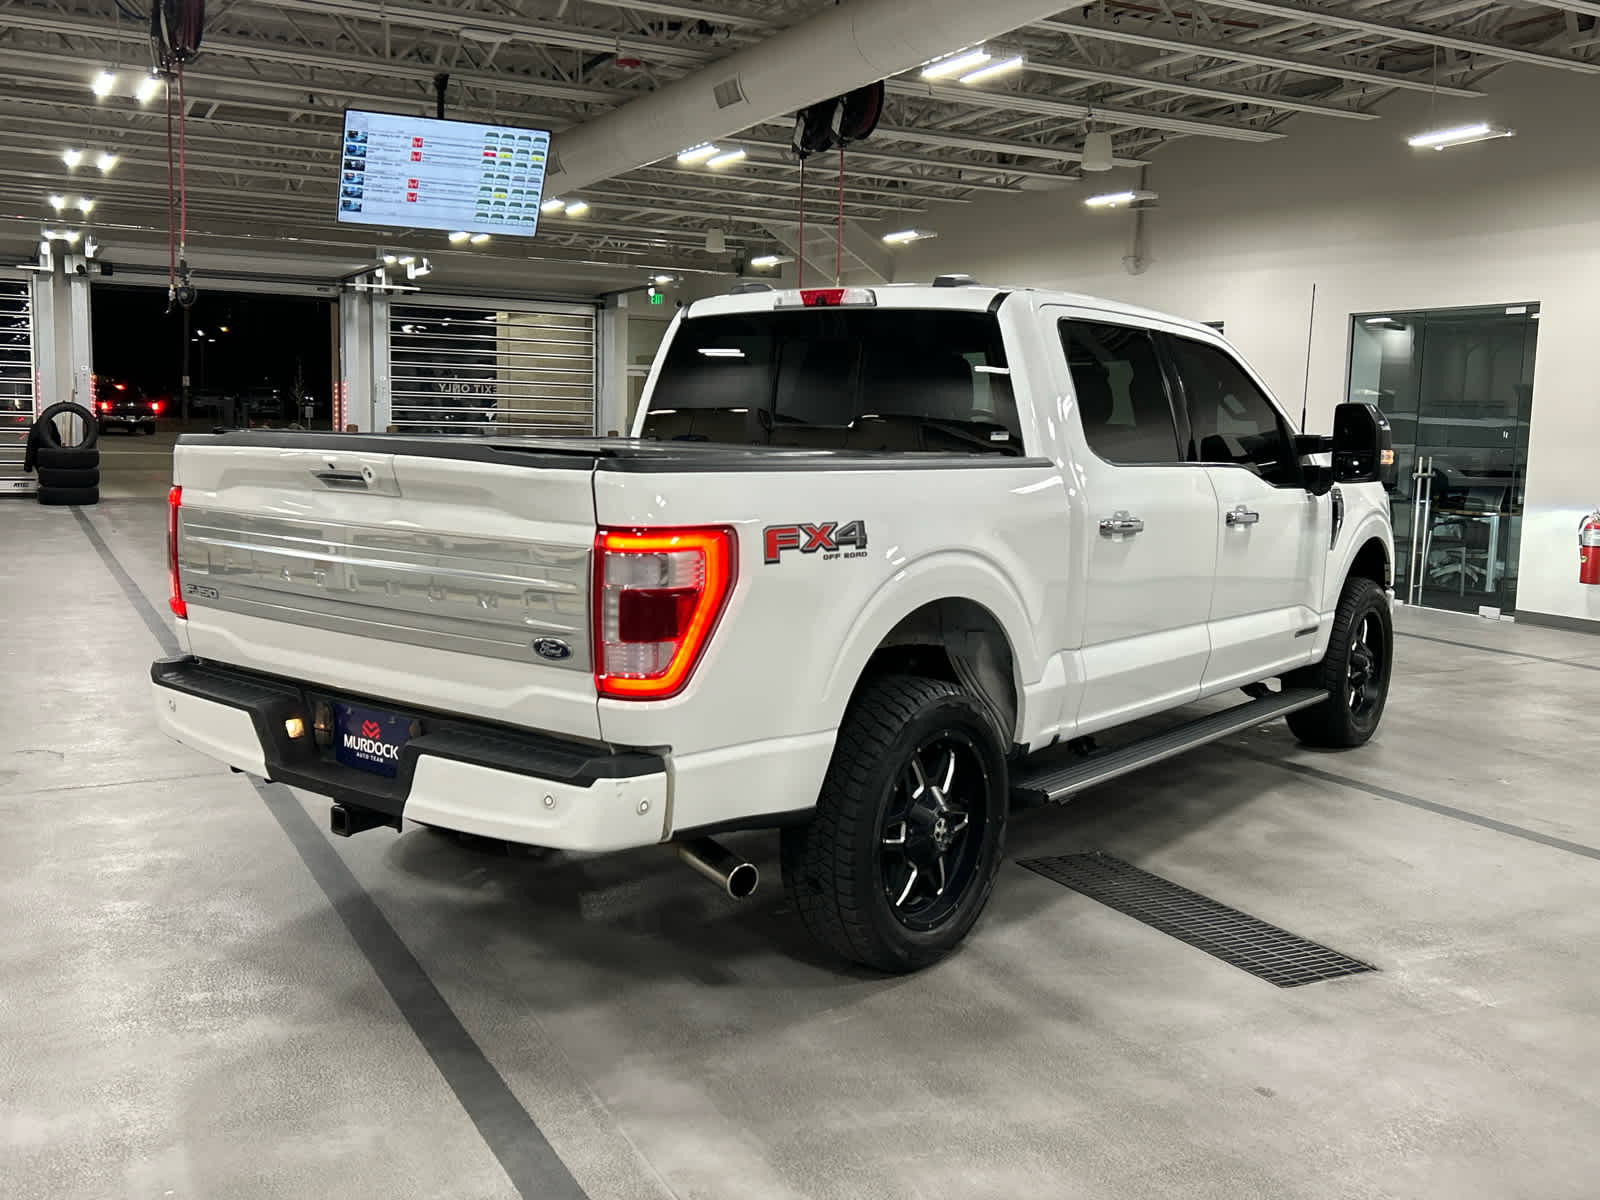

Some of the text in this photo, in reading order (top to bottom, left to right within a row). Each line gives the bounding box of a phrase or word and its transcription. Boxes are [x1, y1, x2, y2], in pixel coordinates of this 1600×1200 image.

[650, 293, 664, 304] EXIT
[763, 520, 867, 564] FX4
[823, 551, 868, 561] OFF ROAD
[537, 639, 565, 657] Ford
[344, 734, 399, 760] MURDOCK
[356, 752, 384, 763] AUTO TEAM
